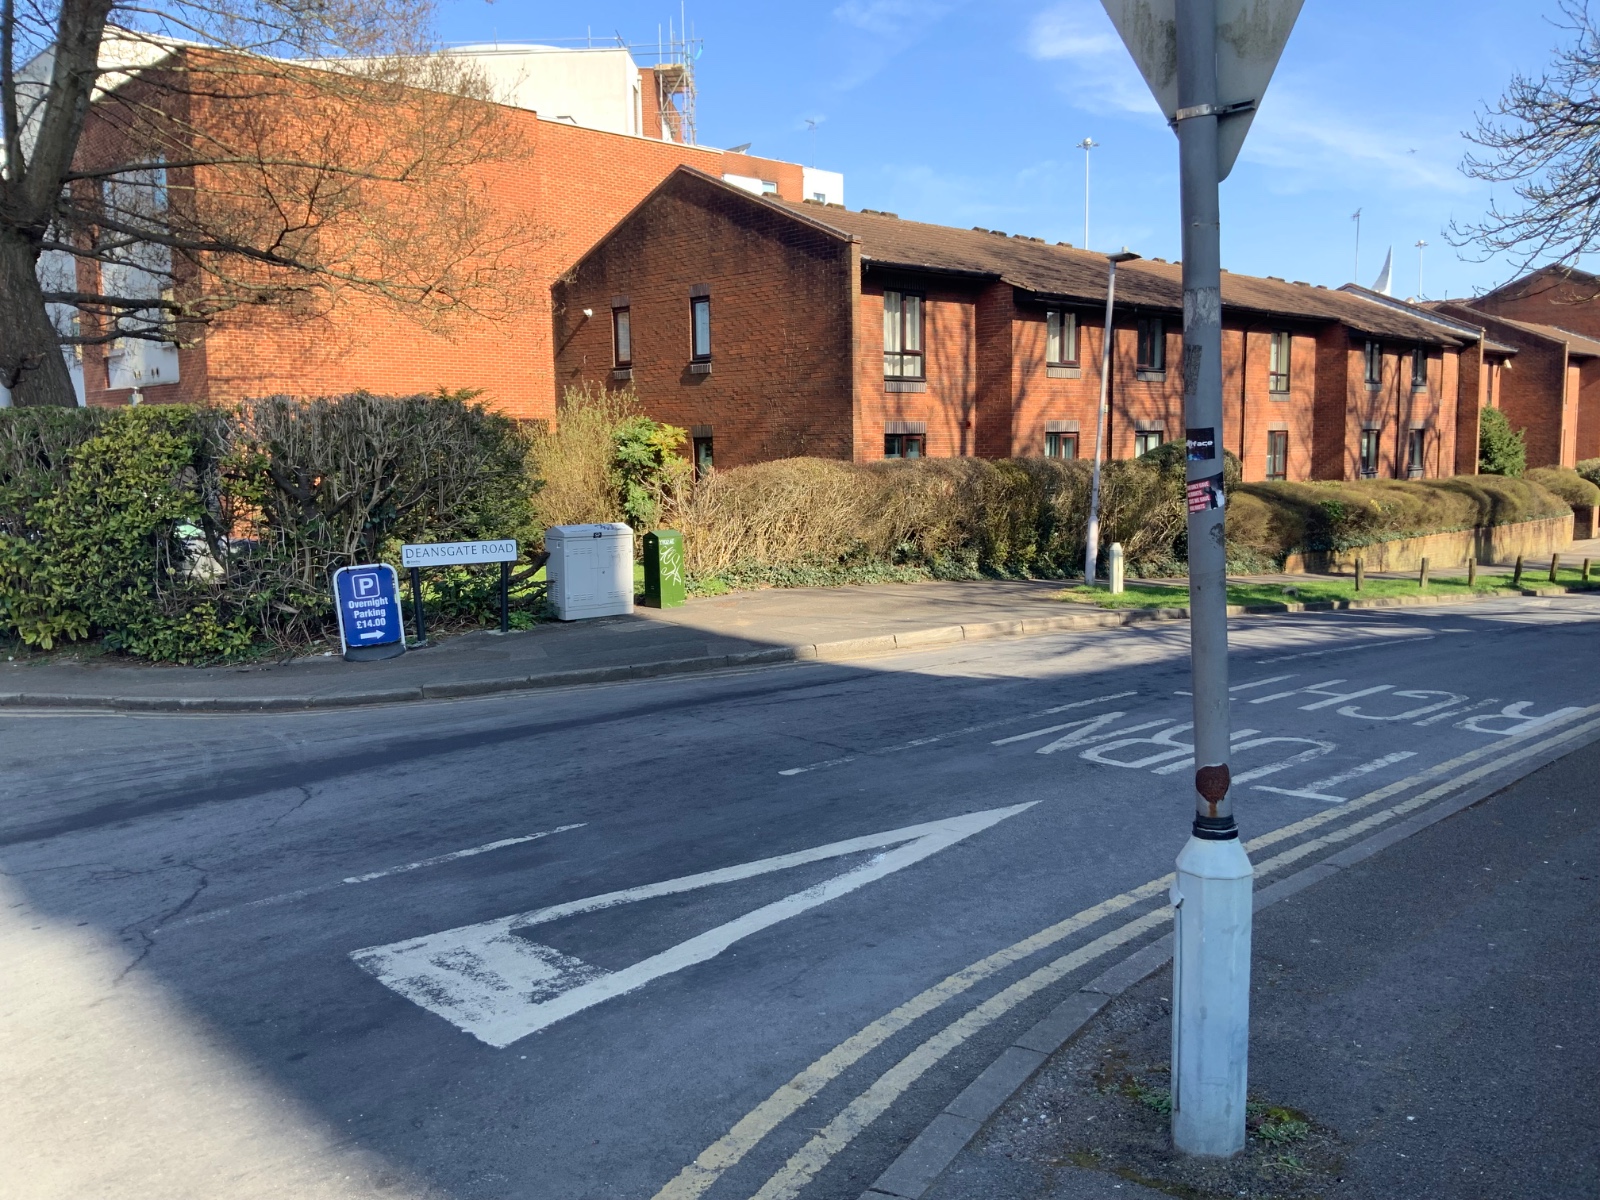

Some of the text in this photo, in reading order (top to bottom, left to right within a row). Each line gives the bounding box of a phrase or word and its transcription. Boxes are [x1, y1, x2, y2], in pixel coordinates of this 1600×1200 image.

[405, 543, 514, 559] DEANSGATE ROAD
[359, 577, 374, 596] P
[348, 596, 389, 609] Overnight
[353, 608, 386, 619] Parking
[356, 617, 387, 629] £14.00
[991, 711, 1418, 802] TURN
